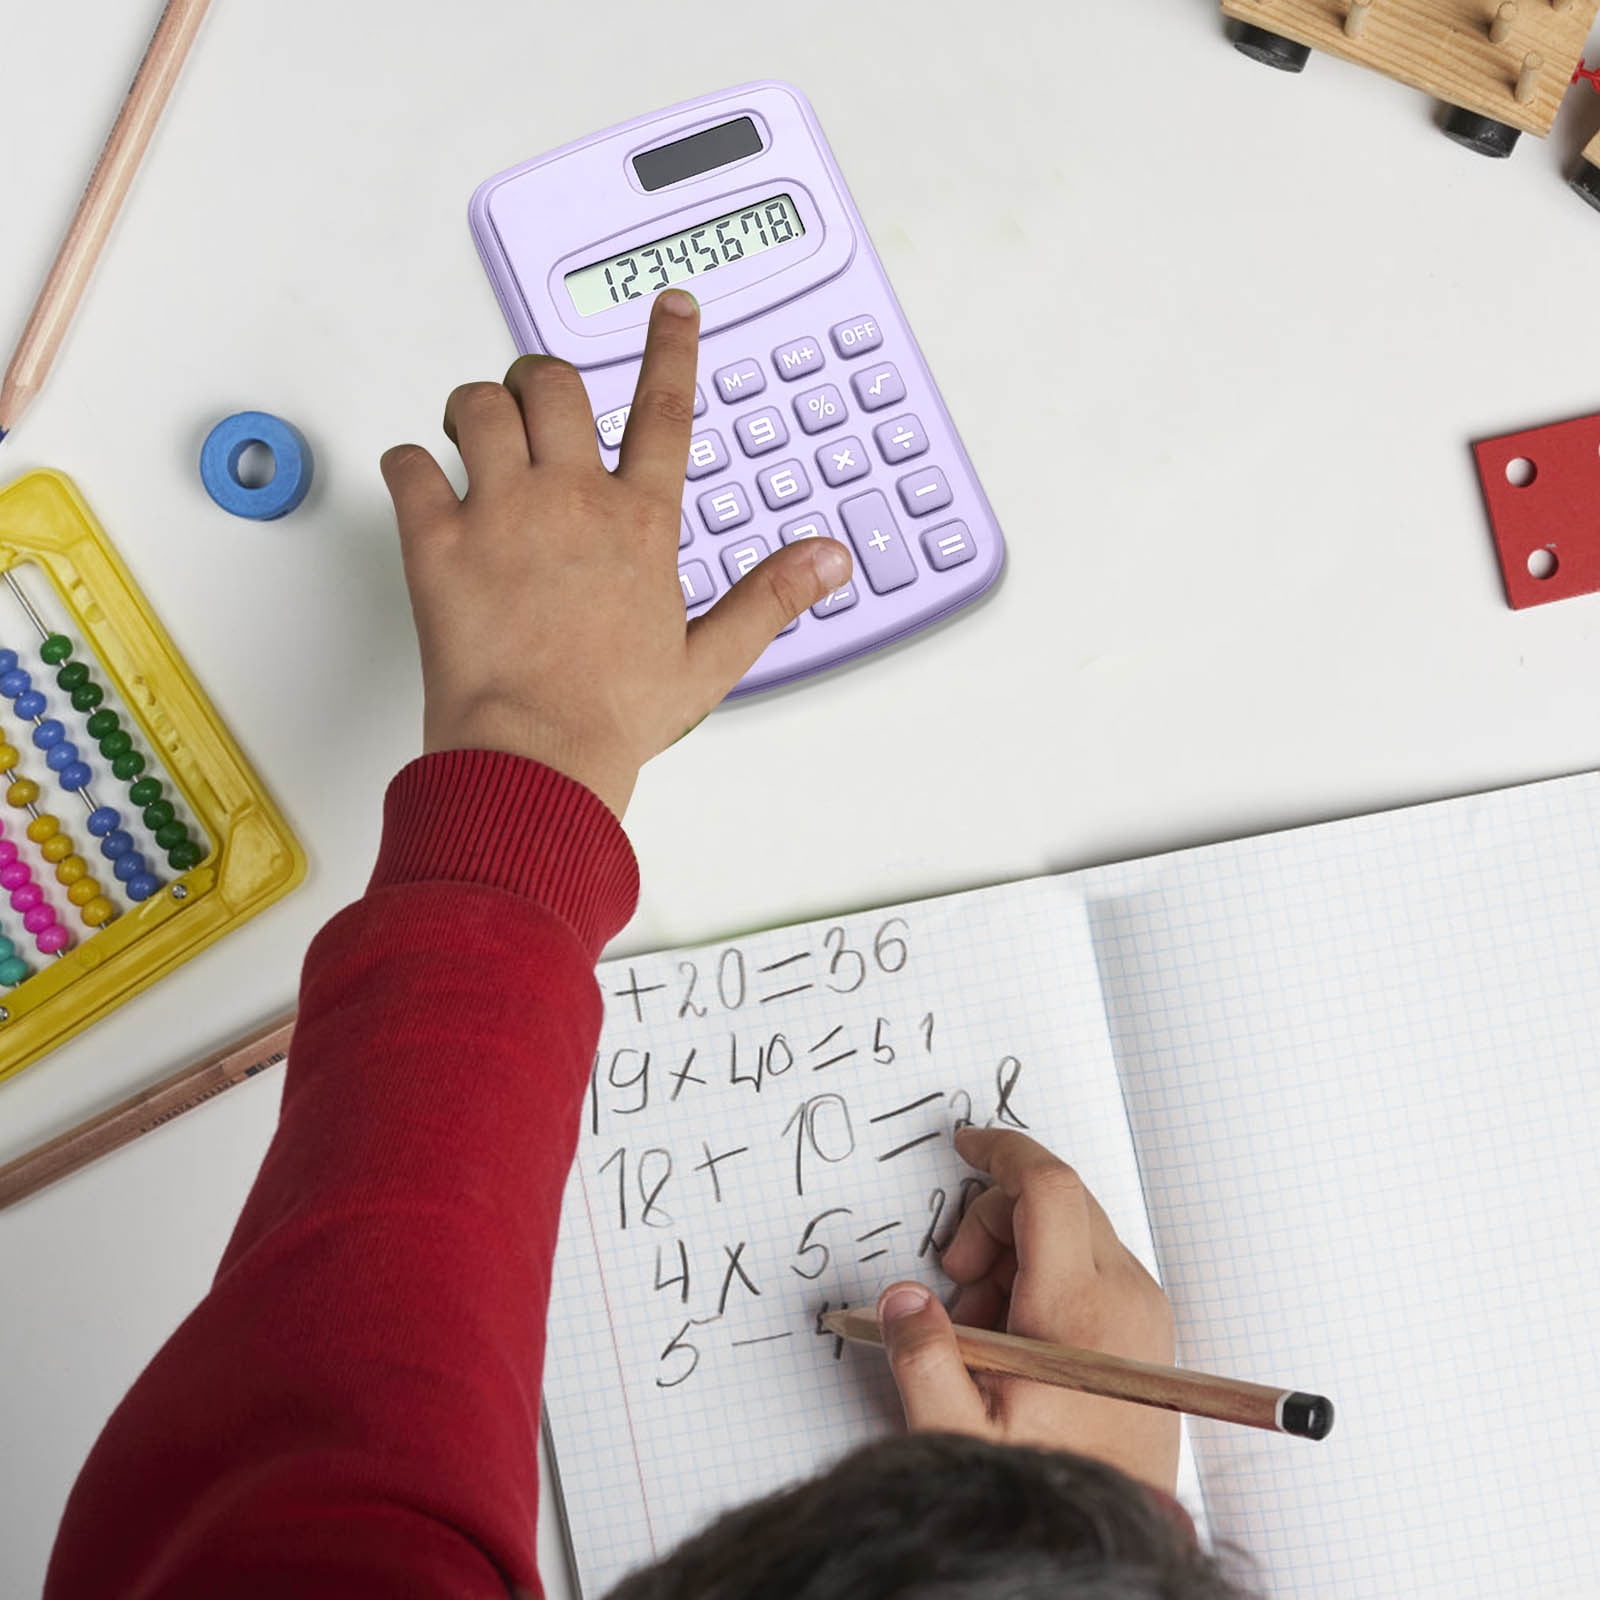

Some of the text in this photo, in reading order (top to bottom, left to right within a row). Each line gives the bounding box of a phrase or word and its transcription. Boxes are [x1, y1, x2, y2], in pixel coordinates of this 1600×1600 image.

[841, 322, 875, 345] OFF
[782, 347, 813, 369] M+
[723, 371, 755, 392] M-
[808, 395, 835, 419] %
[748, 416, 776, 445] 9
[690, 439, 717, 467] 8
[770, 470, 798, 498] 6
[711, 492, 740, 522] 5
[679, 574, 696, 597] 1
